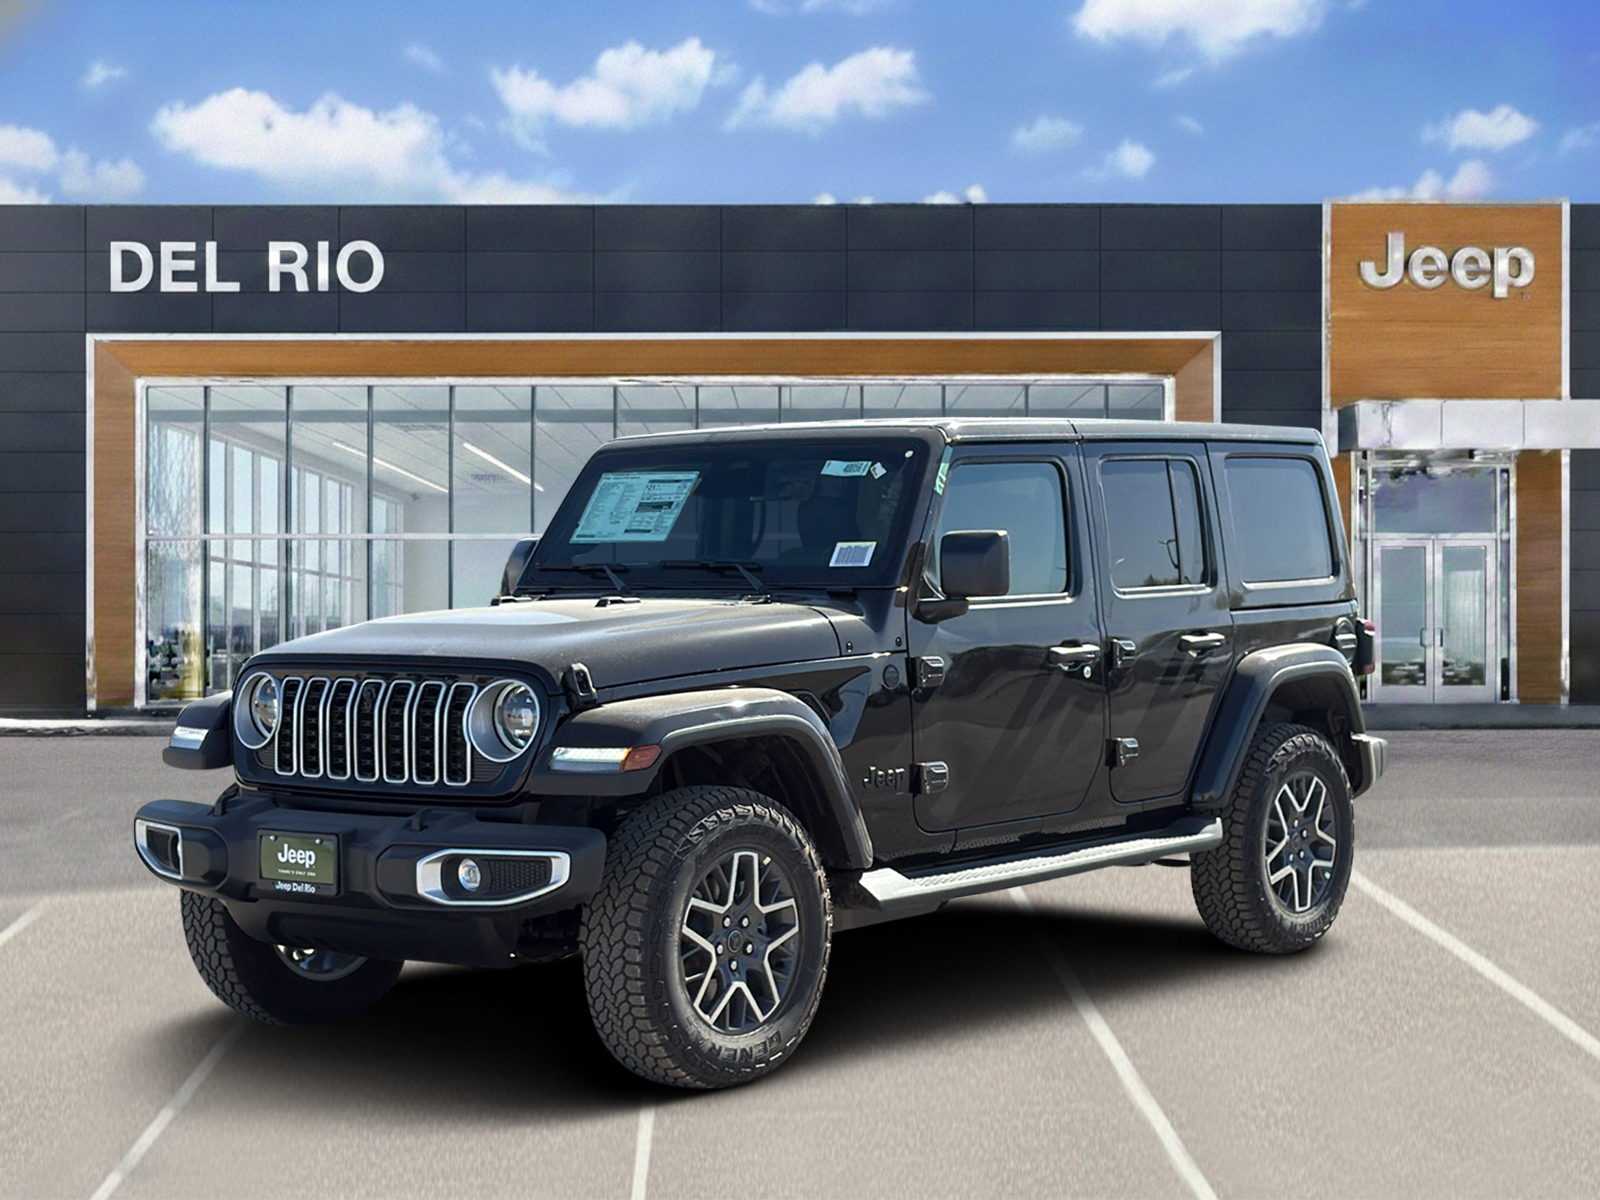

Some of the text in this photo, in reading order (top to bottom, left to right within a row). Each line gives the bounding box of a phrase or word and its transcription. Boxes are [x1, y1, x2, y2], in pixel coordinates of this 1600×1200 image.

[109, 240, 385, 293] DEL RIO
[1360, 231, 1536, 299] Jeep
[862, 765, 906, 794] Jeep
[277, 843, 316, 868] Jeep
[275, 880, 316, 894] Jeep Del Rio
